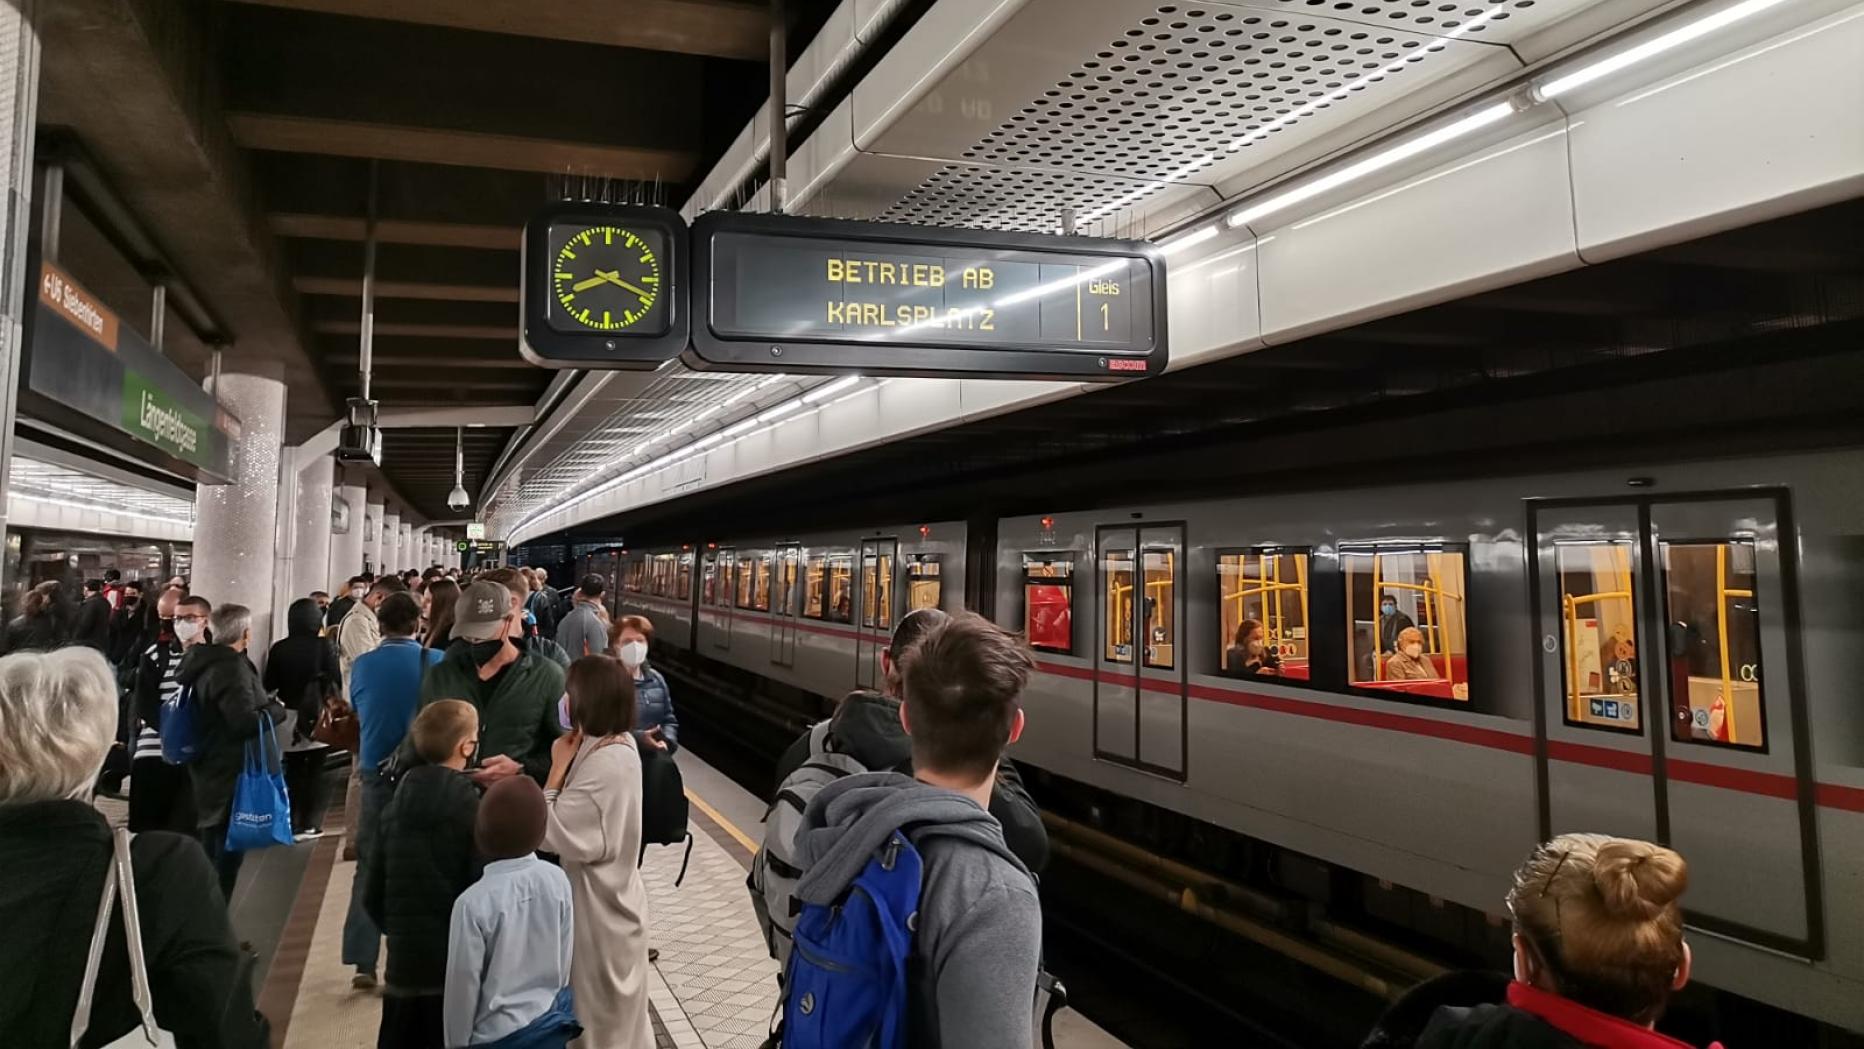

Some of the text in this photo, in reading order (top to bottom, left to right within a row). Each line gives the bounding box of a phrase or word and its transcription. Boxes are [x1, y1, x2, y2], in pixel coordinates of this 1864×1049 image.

[827, 258, 994, 289] BETRIEB AB
[1088, 279, 1120, 295] Gleis
[827, 301, 994, 330] KARLSPLATZ
[1100, 303, 1109, 331] 1
[141, 389, 197, 453] Längenfeldgasse
